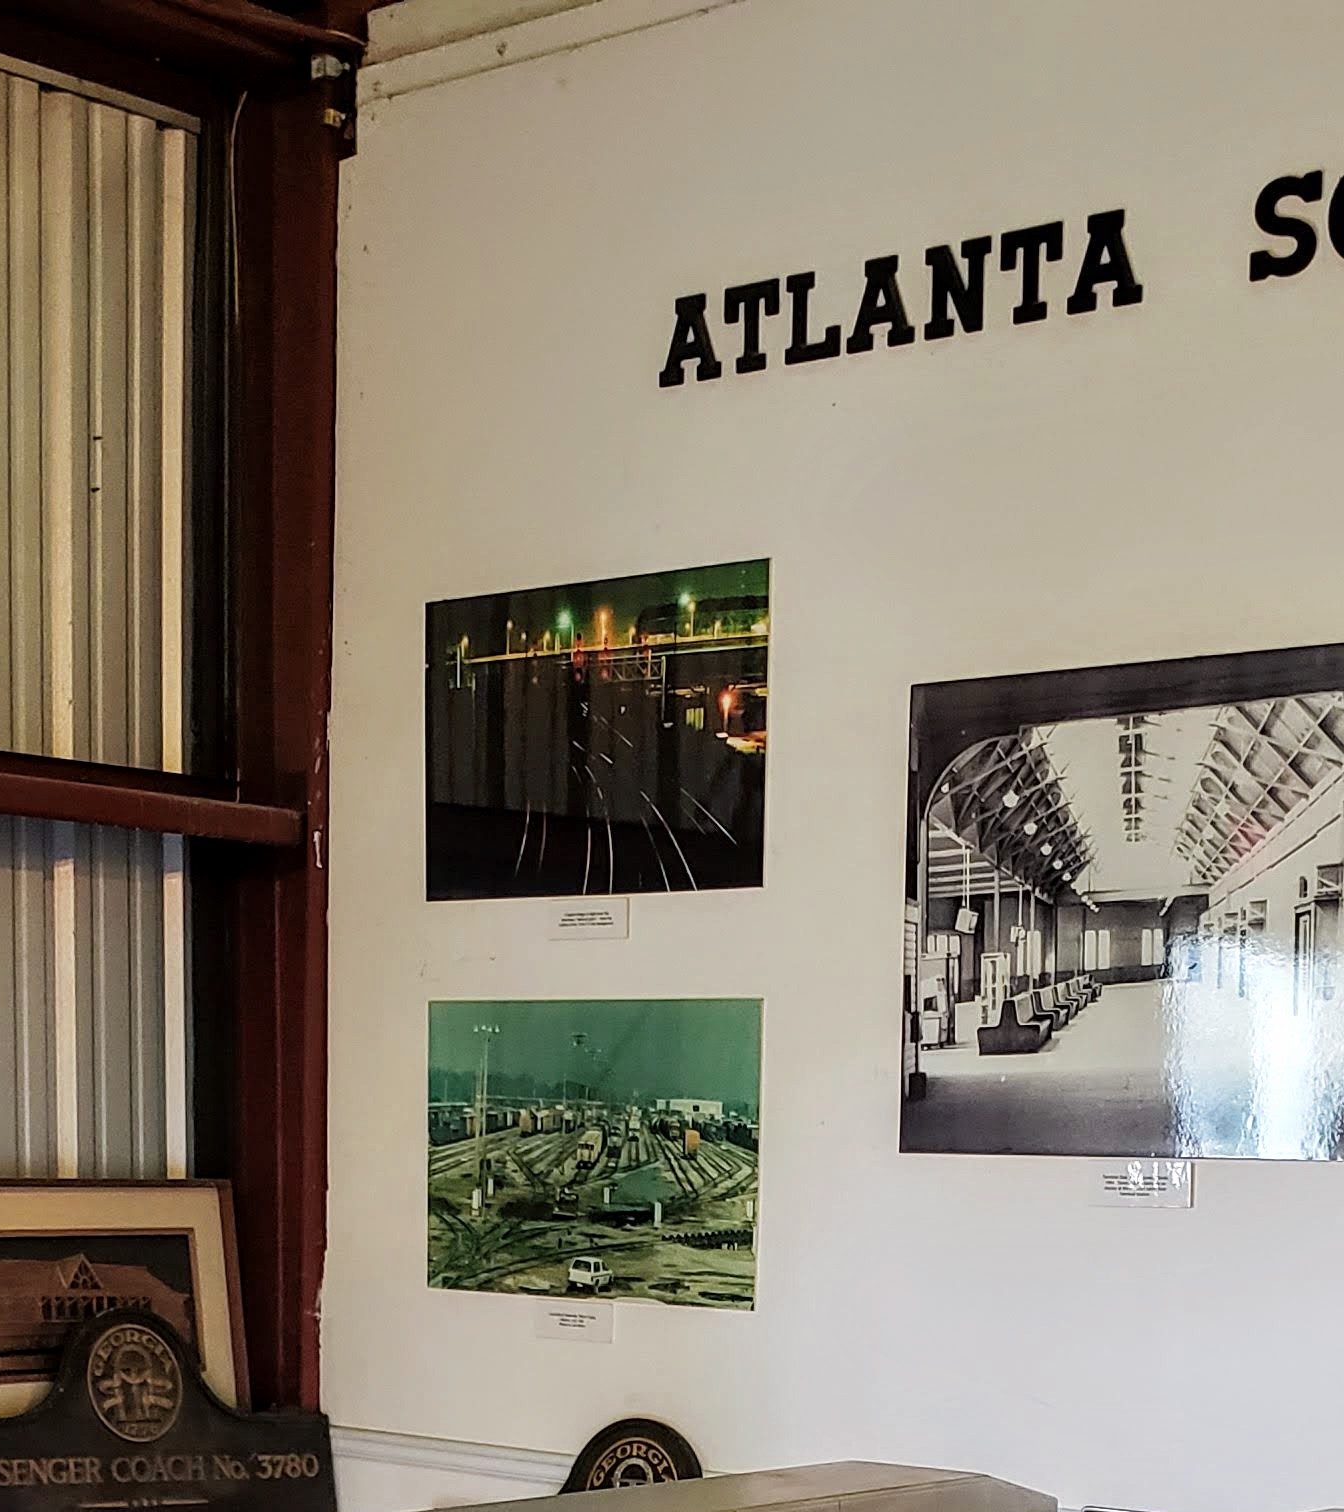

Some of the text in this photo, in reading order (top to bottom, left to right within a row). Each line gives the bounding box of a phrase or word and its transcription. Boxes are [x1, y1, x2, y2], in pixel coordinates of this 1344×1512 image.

[658, 208, 1143, 389] ATLANTA
[111, 1455, 206, 1484] COACH
[214, 1455, 250, 1481] No.
[256, 1454, 319, 1480] 3780
